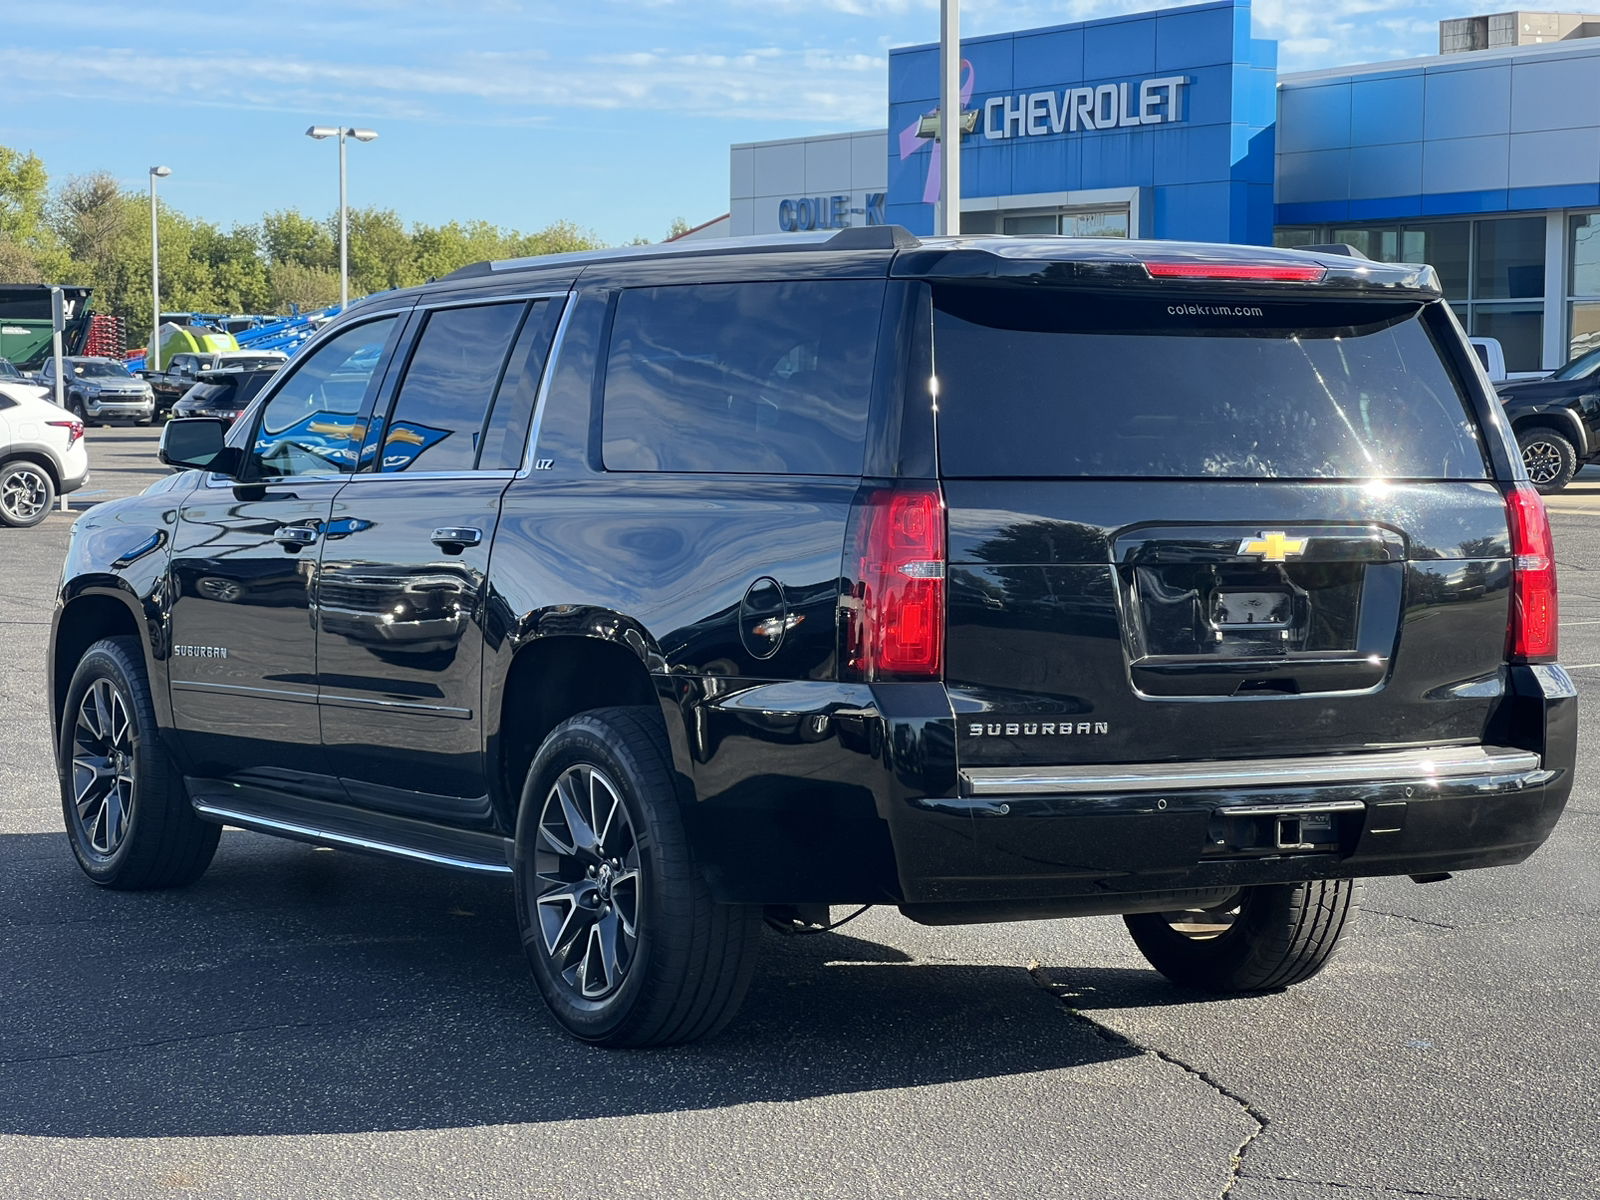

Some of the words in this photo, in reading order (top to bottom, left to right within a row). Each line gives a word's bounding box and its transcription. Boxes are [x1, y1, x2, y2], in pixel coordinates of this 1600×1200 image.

[984, 76, 1189, 140] CHEVROLET
[1167, 304, 1263, 317] colekrum.com
[535, 458, 554, 470] LTZ
[174, 645, 228, 659] SUBURBAN
[969, 722, 1108, 736] SUBURBAN
